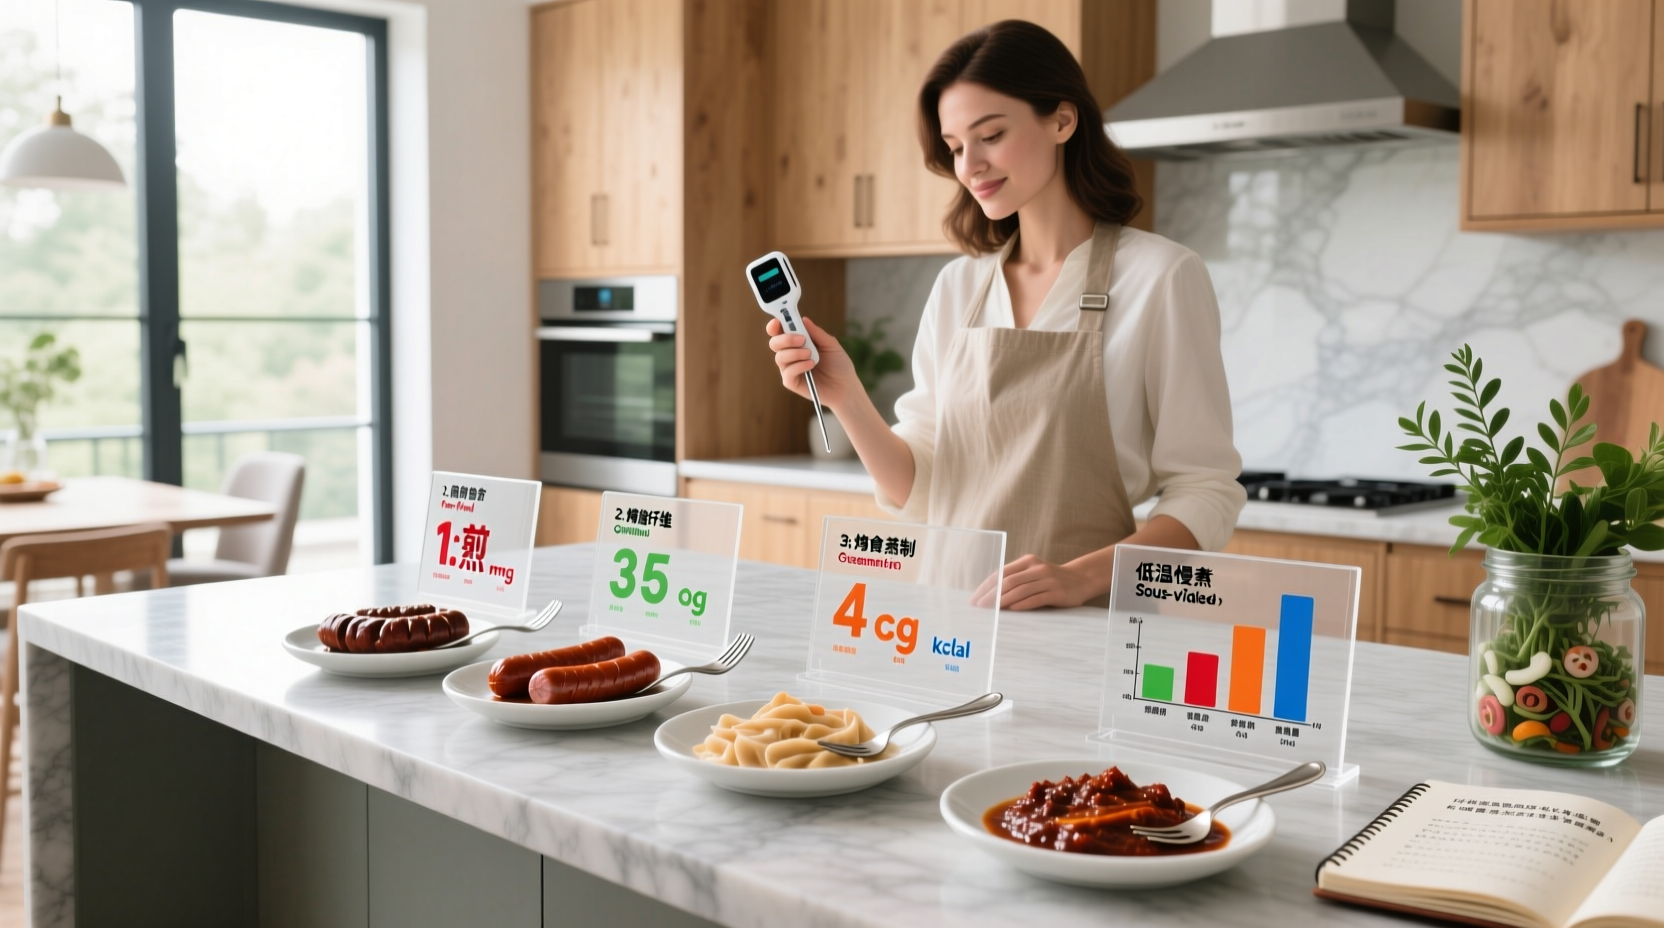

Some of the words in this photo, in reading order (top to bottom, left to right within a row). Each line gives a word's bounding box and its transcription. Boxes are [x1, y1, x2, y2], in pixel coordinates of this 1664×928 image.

[610, 548, 670, 604] 35
[678, 588, 707, 616] og
[832, 582, 868, 638] 4
[874, 614, 919, 655] cg
